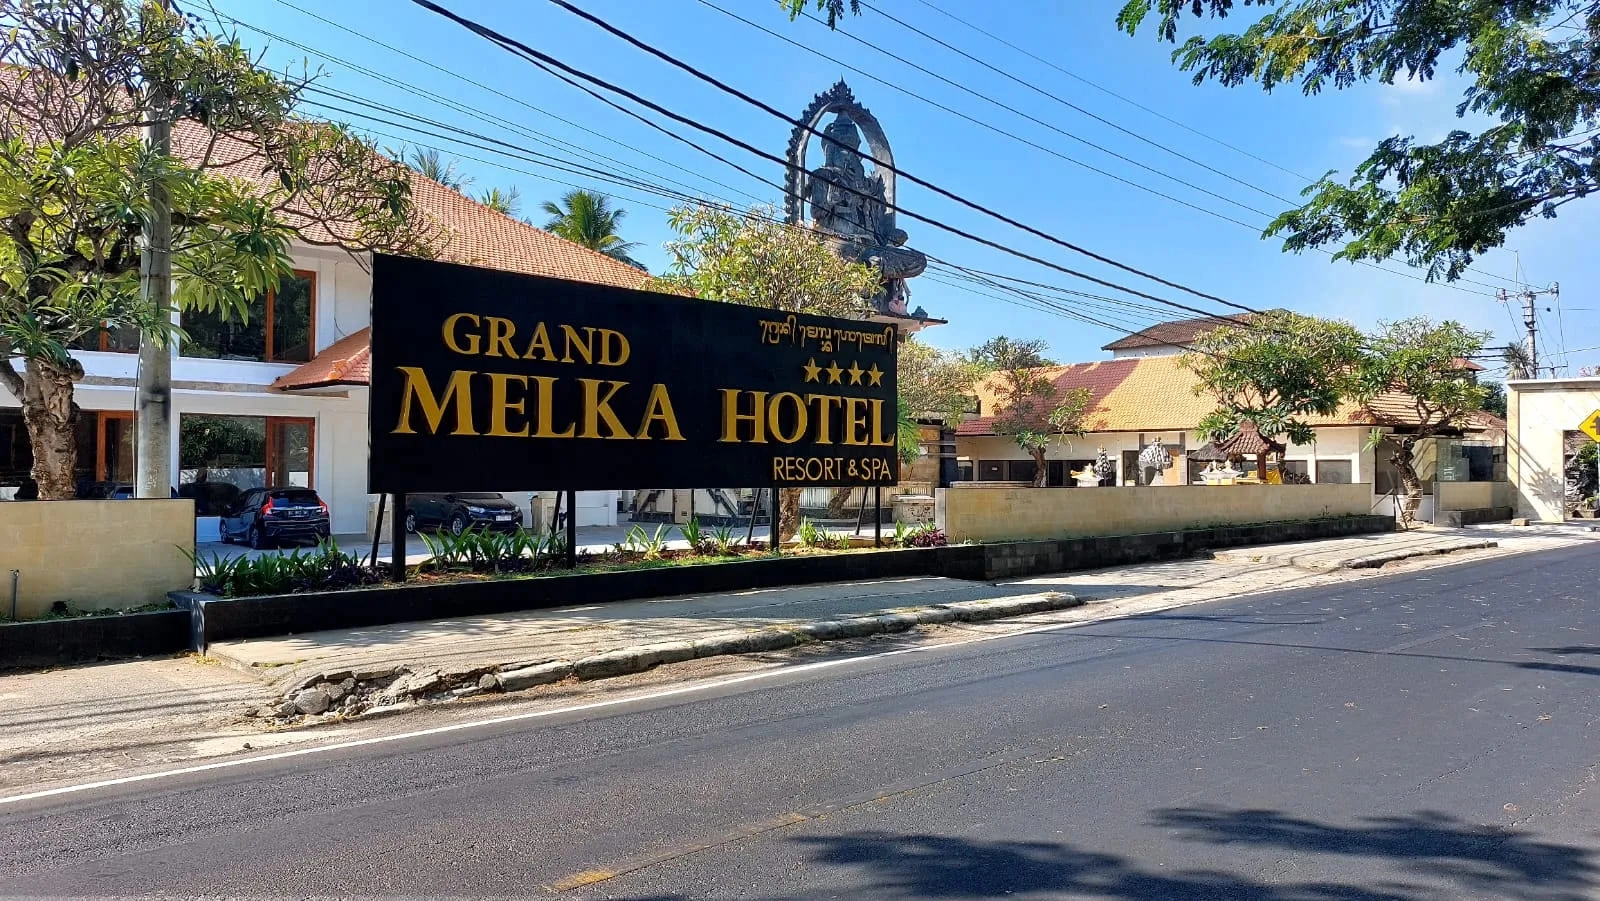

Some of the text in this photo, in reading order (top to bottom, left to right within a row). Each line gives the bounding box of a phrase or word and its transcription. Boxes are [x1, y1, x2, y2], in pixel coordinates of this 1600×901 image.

[442, 312, 631, 367] GRAND
[391, 366, 895, 447] MELKA HOTEL
[772, 456, 892, 482] RESORT & SPA
